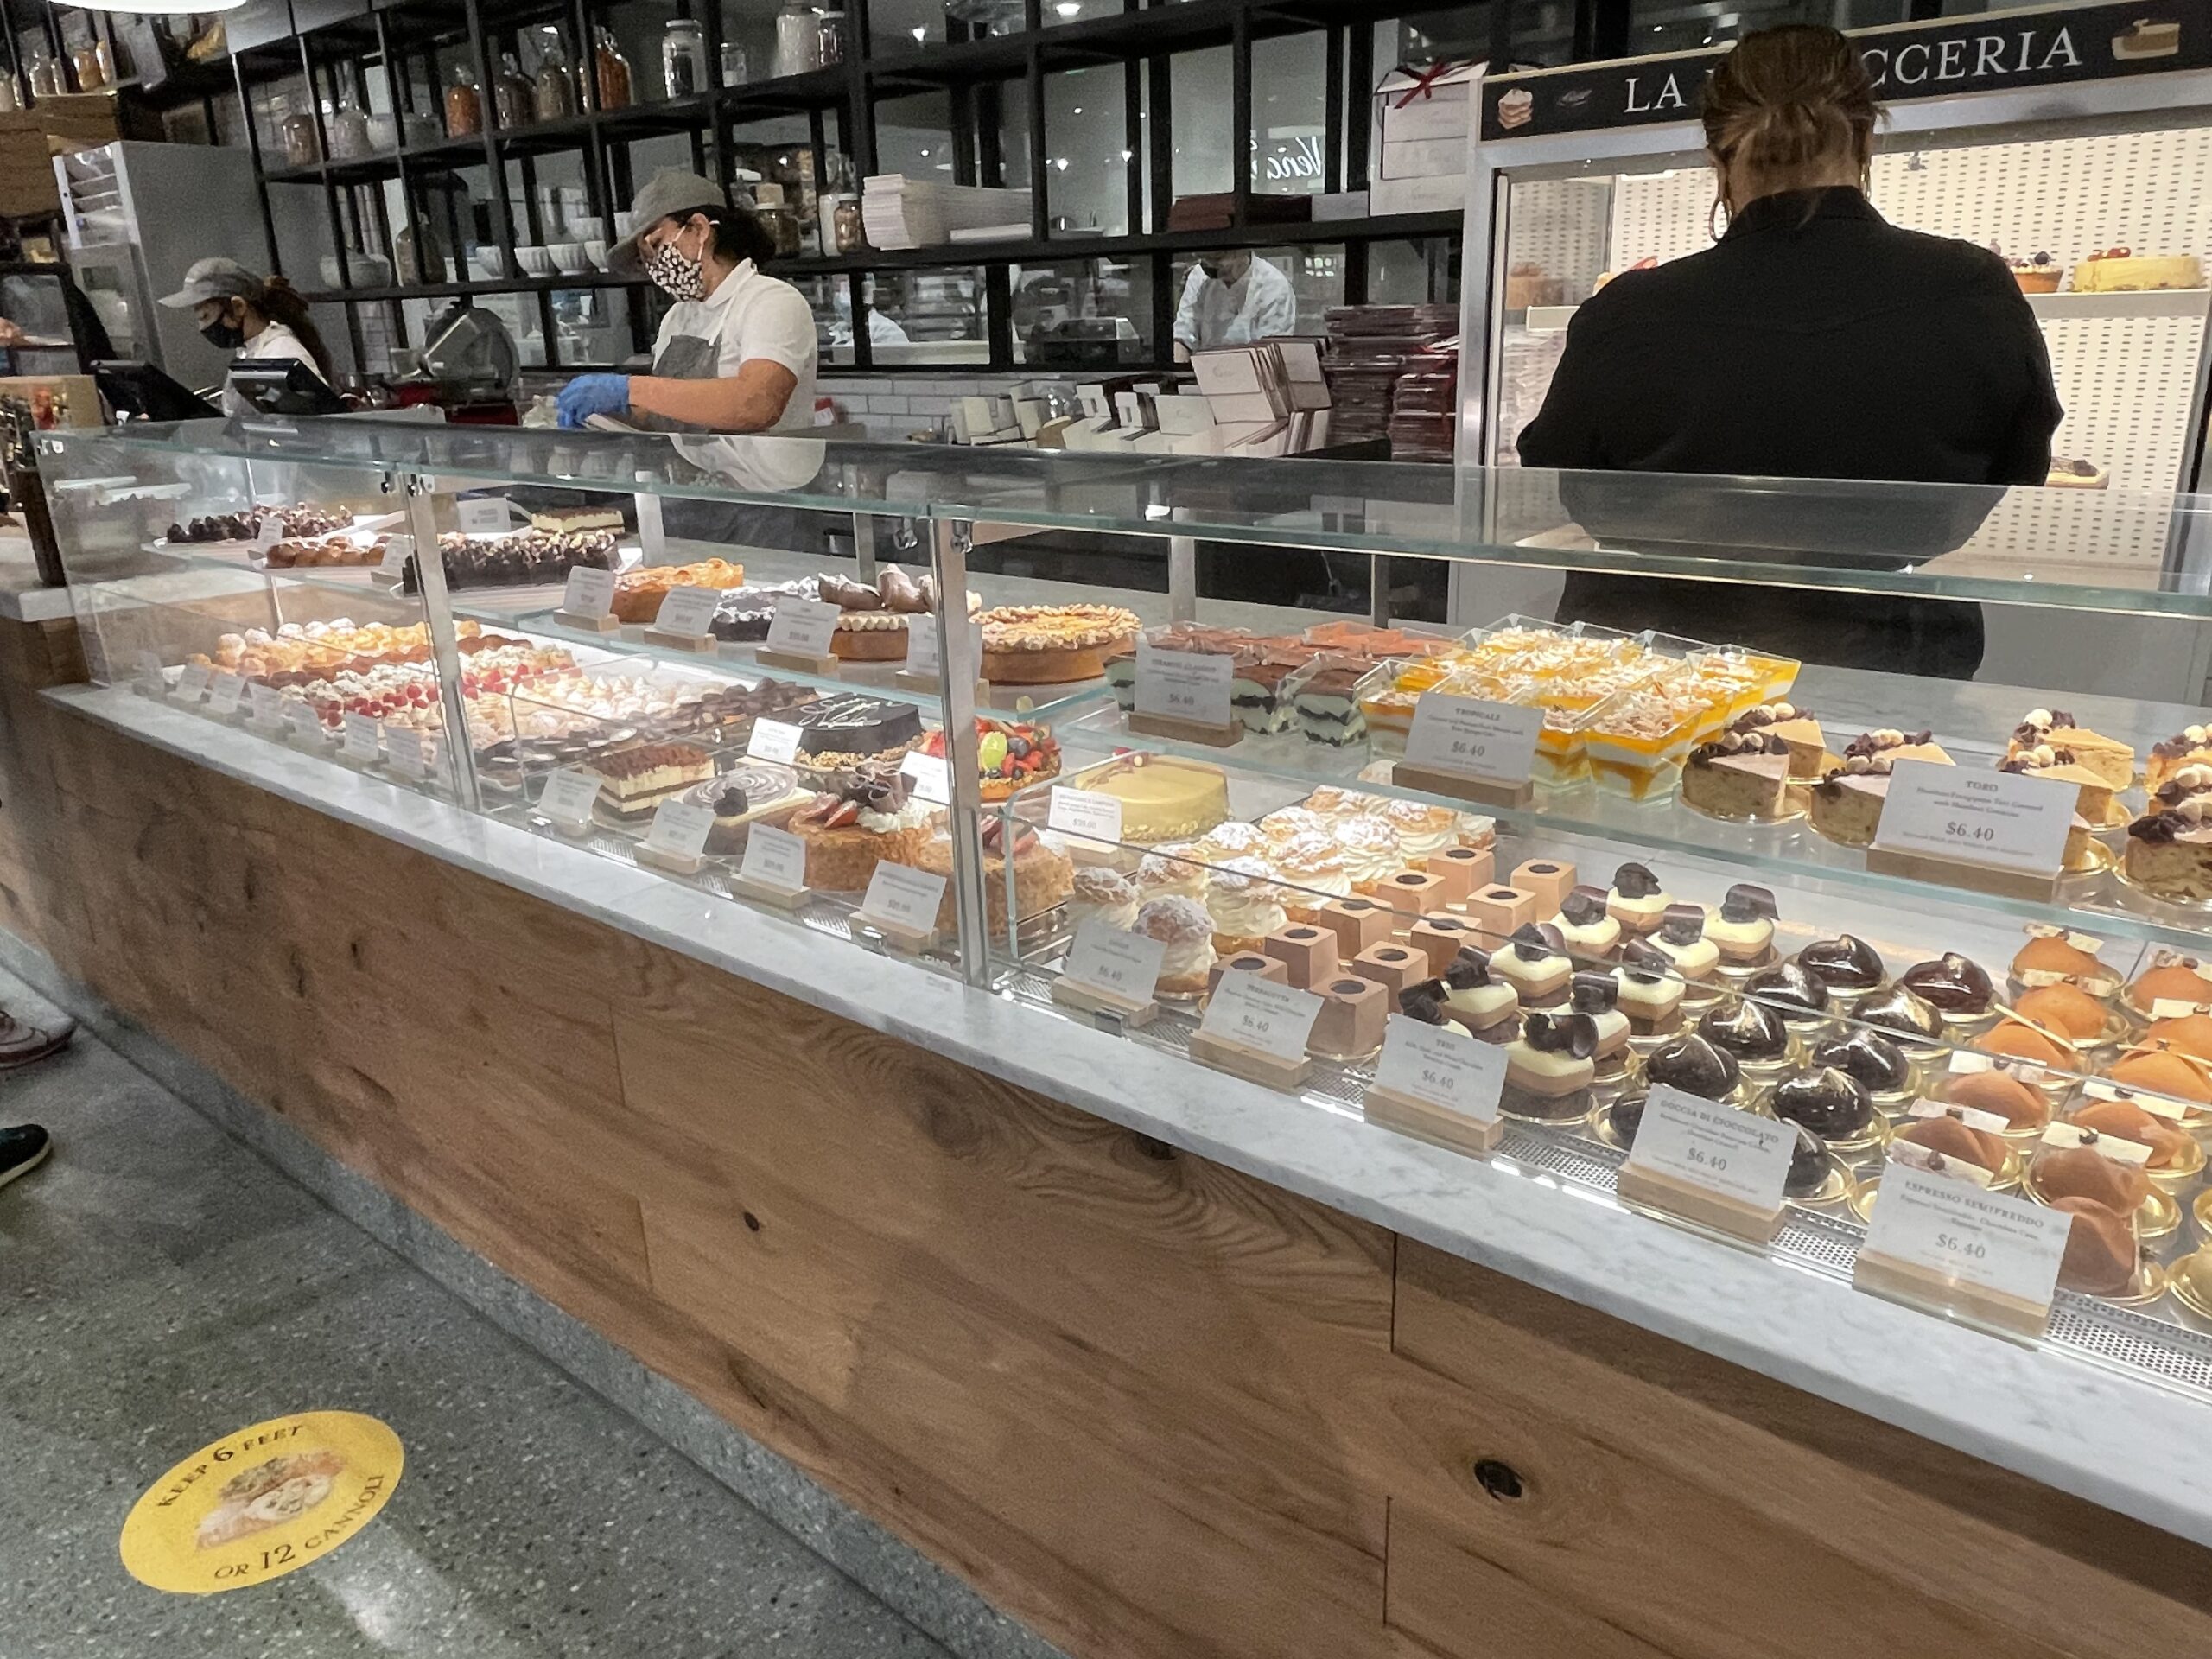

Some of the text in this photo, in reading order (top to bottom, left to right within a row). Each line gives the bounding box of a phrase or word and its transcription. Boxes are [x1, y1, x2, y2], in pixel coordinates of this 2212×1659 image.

[1624, 73, 1688, 113] LA
[1451, 741, 1486, 758] $6.40
[1945, 820, 1995, 842] $6.40
[1421, 1069, 1454, 1090] $6.40
[1687, 1146, 1727, 1171] $6.40
[1904, 1180, 1961, 1205] ESPRESSO
[1964, 1195, 2044, 1229] SEMIFREDDO
[1936, 1232, 1986, 1260] $6.40
[157, 1424, 303, 1509] KEEP 6 FEET
[213, 1474, 385, 1580] OR 12 CANNOLI
